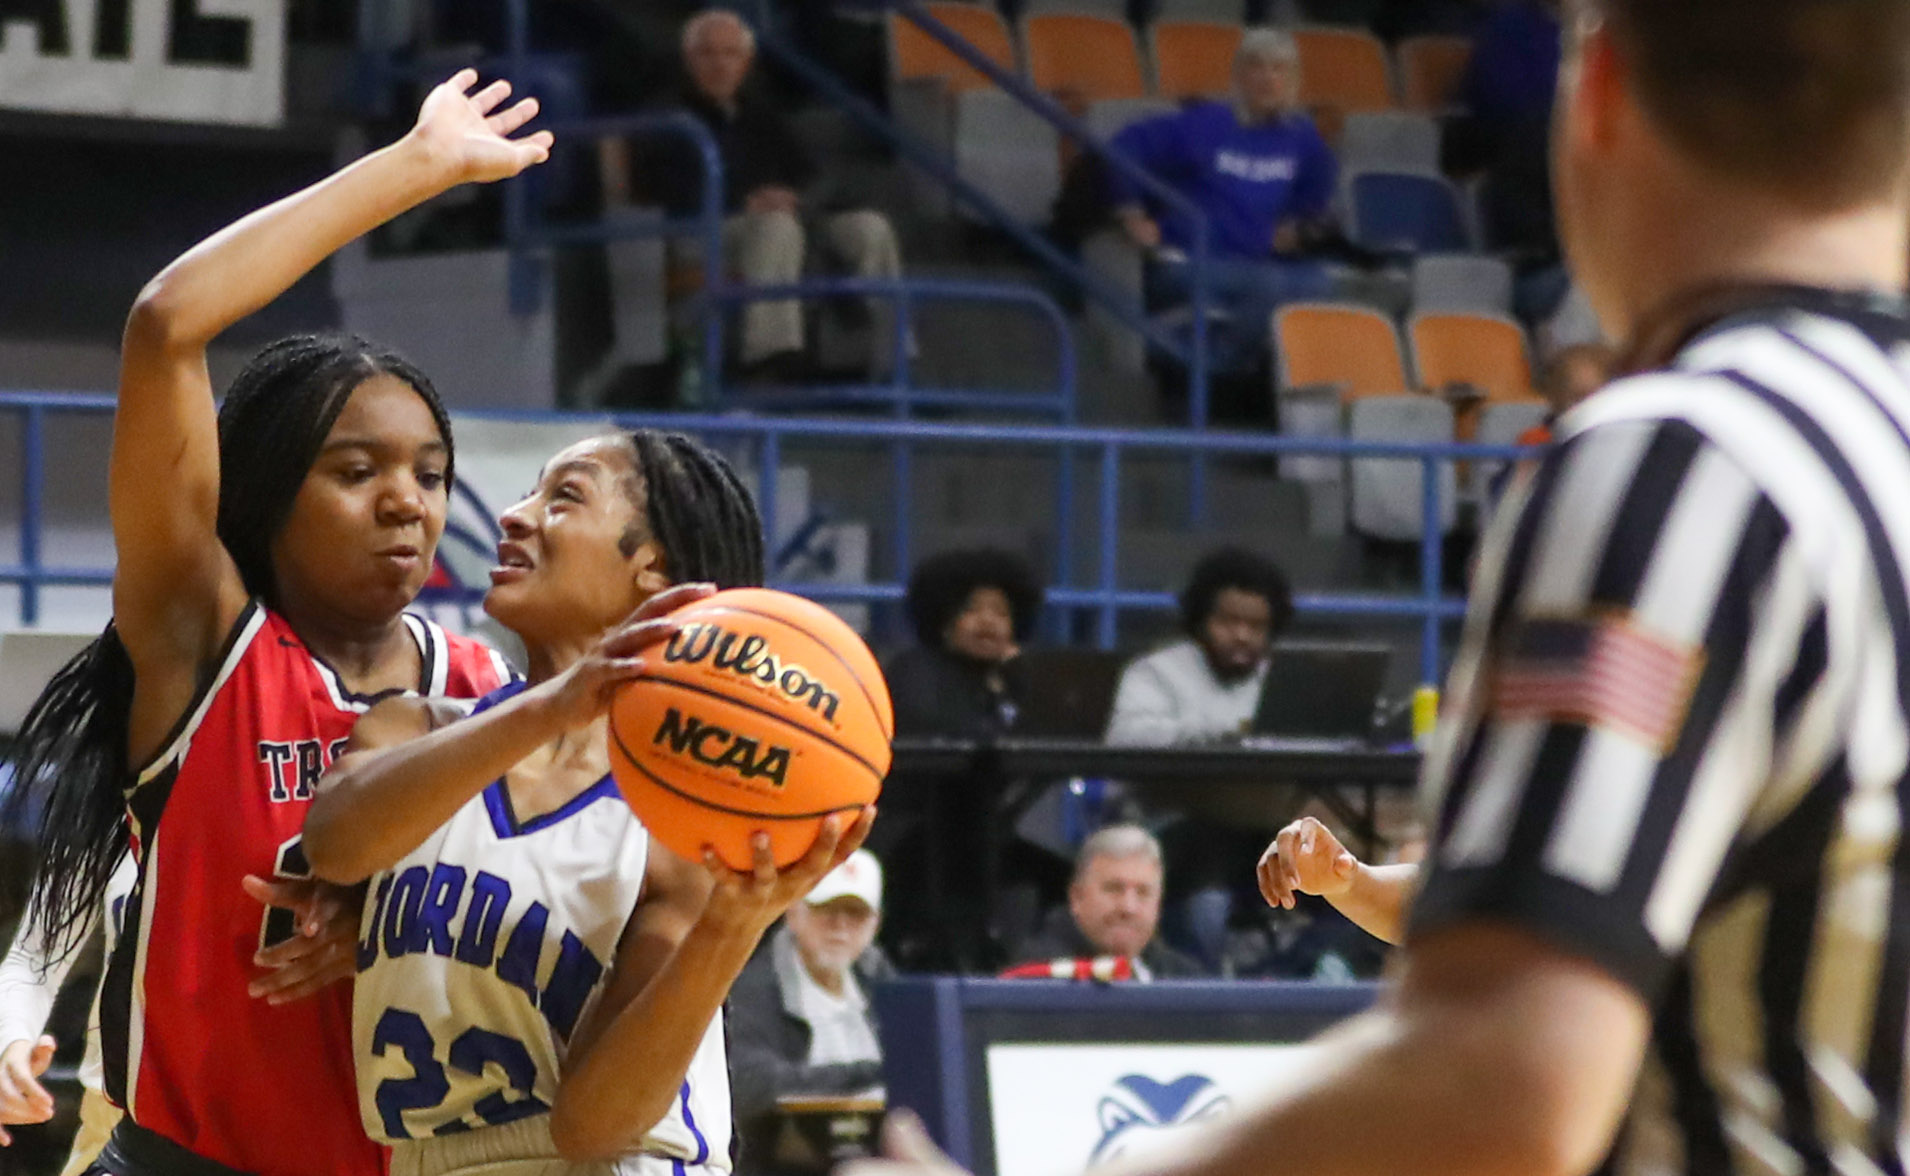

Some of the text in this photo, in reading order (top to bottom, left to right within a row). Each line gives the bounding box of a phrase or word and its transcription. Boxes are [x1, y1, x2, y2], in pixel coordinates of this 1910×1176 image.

[663, 622, 842, 724] Wilson
[258, 737, 350, 803] TR
[652, 706, 792, 788] NCAA
